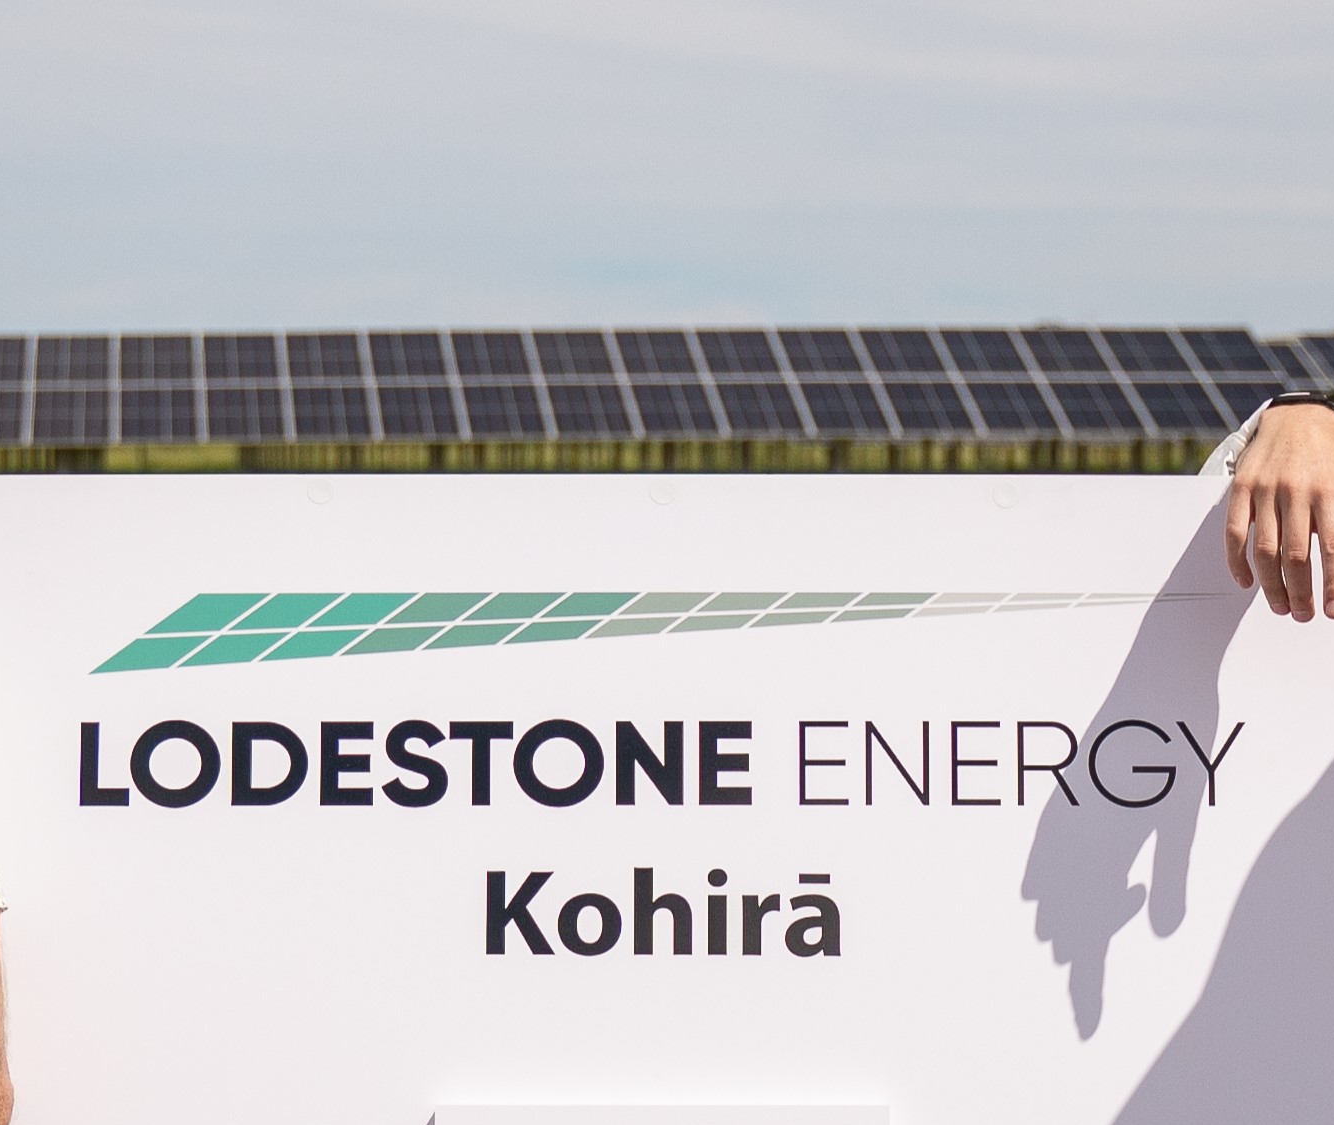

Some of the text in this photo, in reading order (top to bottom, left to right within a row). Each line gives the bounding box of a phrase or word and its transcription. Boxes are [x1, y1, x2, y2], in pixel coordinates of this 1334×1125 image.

[79, 719, 1246, 809] LODESTONE ENERGY
[485, 867, 841, 958] Kohirā
